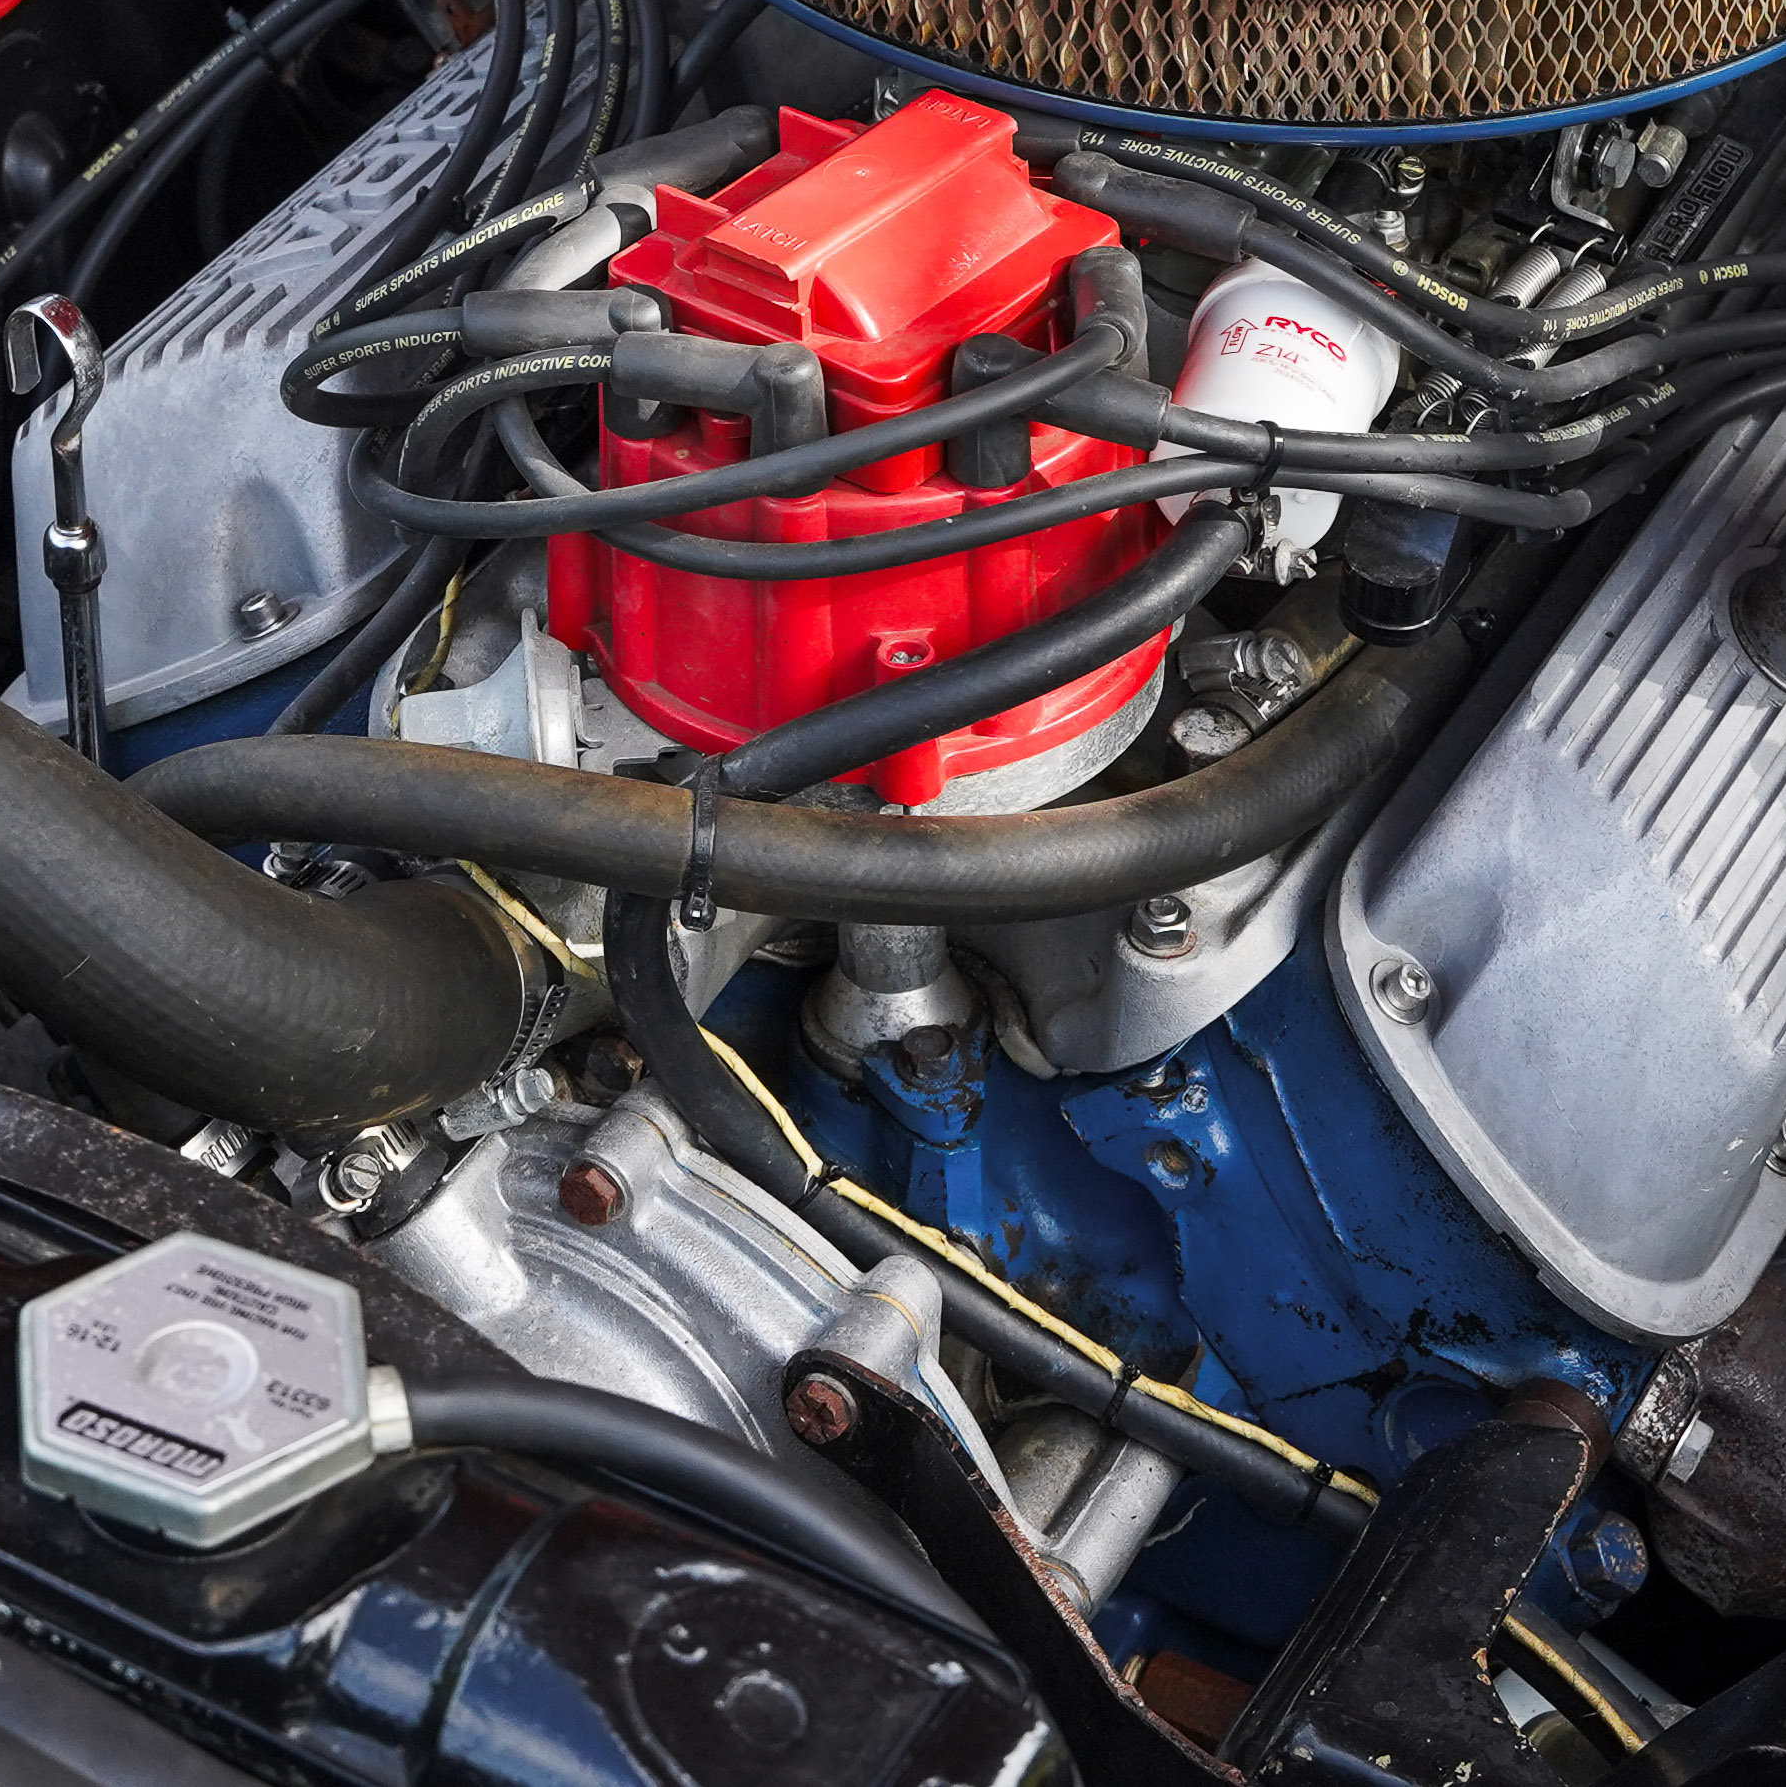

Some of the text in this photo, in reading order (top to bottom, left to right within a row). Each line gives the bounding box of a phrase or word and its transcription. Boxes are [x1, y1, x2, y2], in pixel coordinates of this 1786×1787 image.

[354, 284, 389, 313] SUPER
[389, 255, 440, 293] SPORTS
[442, 213, 520, 263] INDUCTIVE
[520, 191, 565, 222] CORE
[579, 178, 597, 197] 11
[731, 215, 808, 251] LATCH
[1080, 130, 1470, 313] BOSCH SUPER SPORTS INDUCTIVE CORE 112
[1542, 262, 1749, 333] BOSCH SUPER SPORTS INDUCTIVE CORE 112
[303, 356, 338, 381] SUPER
[337, 340, 392, 366] SPORTS
[1228, 326, 1245, 347] FLOW
[1265, 316, 1347, 362] RYCO
[416, 394, 444, 427] SUPER
[442, 371, 493, 403] SPORTS
[493, 355, 577, 382] INDUCTIVE
[577, 353, 613, 371] COR
[61, 1408, 222, 1478] MOROSO
